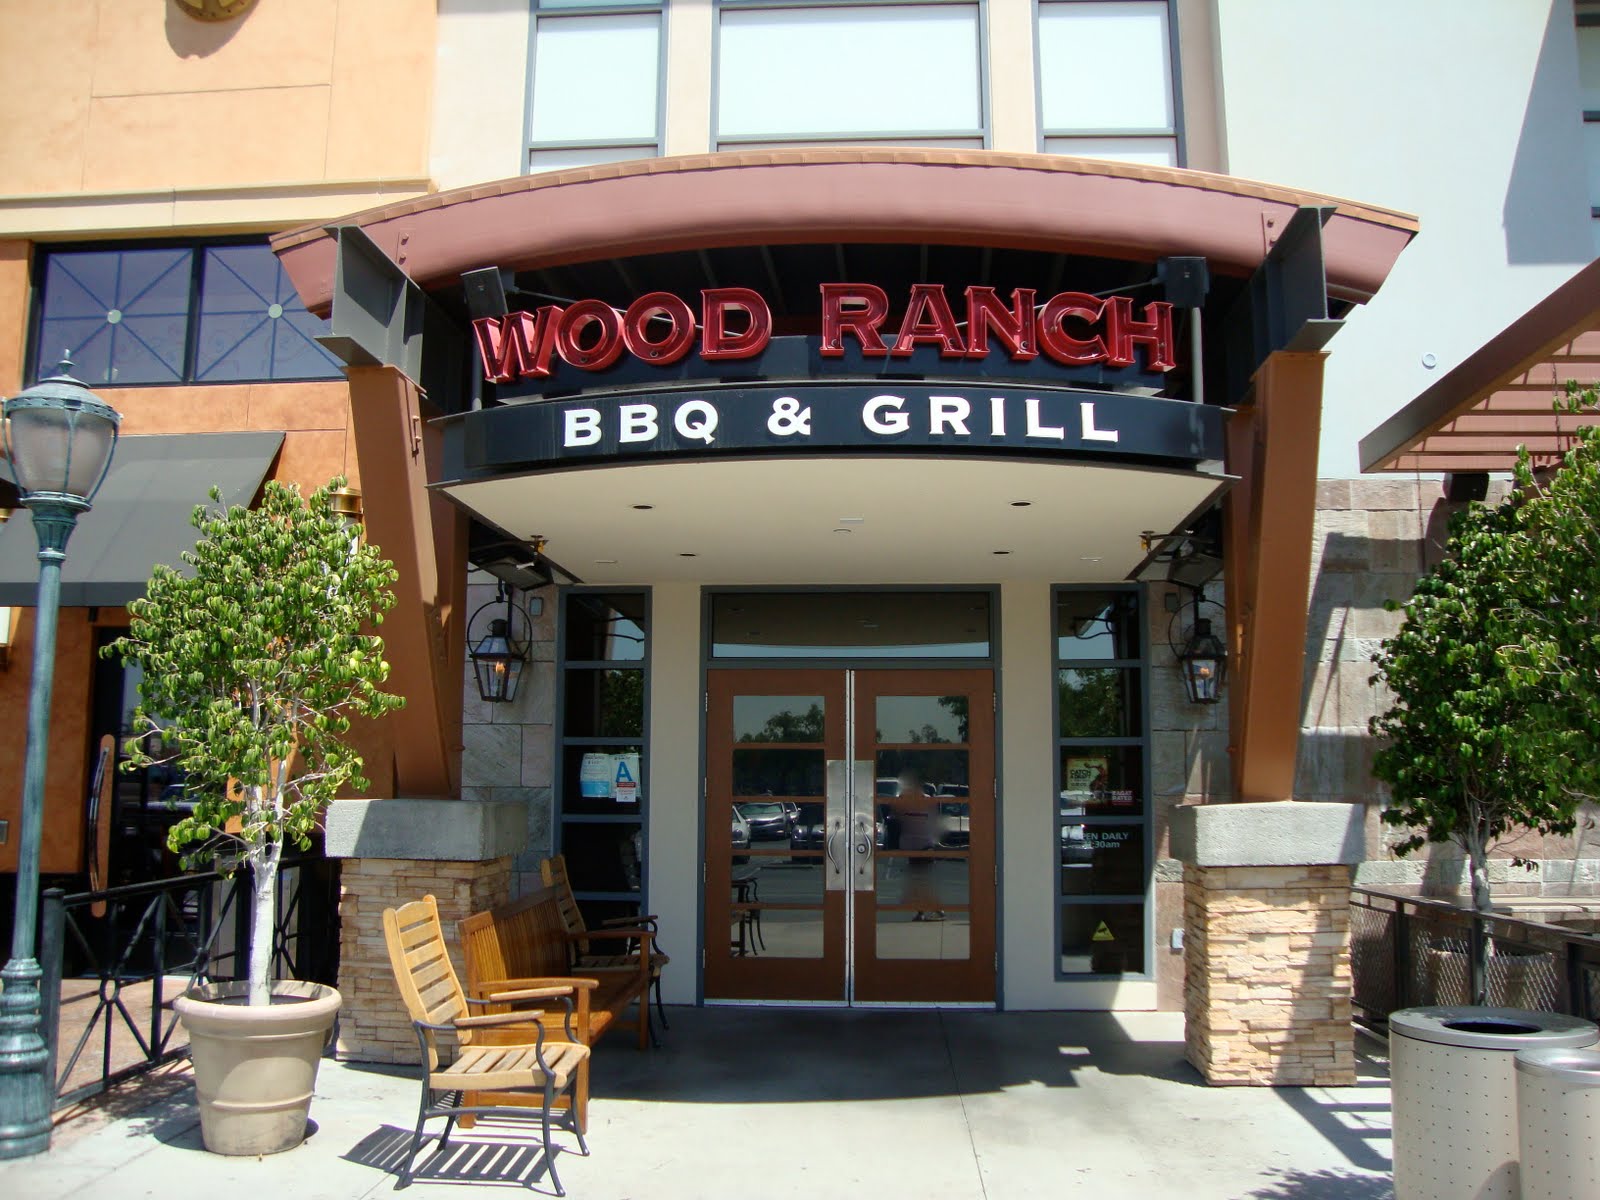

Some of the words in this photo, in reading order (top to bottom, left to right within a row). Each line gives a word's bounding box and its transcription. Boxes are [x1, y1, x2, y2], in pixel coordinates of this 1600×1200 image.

[472, 287, 773, 384] WOOD
[819, 282, 1177, 372] RANCH
[564, 400, 719, 448] BBQ
[767, 396, 811, 436] &
[862, 394, 1119, 443] GRILL
[615, 761, 633, 783] A
[1102, 832, 1129, 840] DAILY
